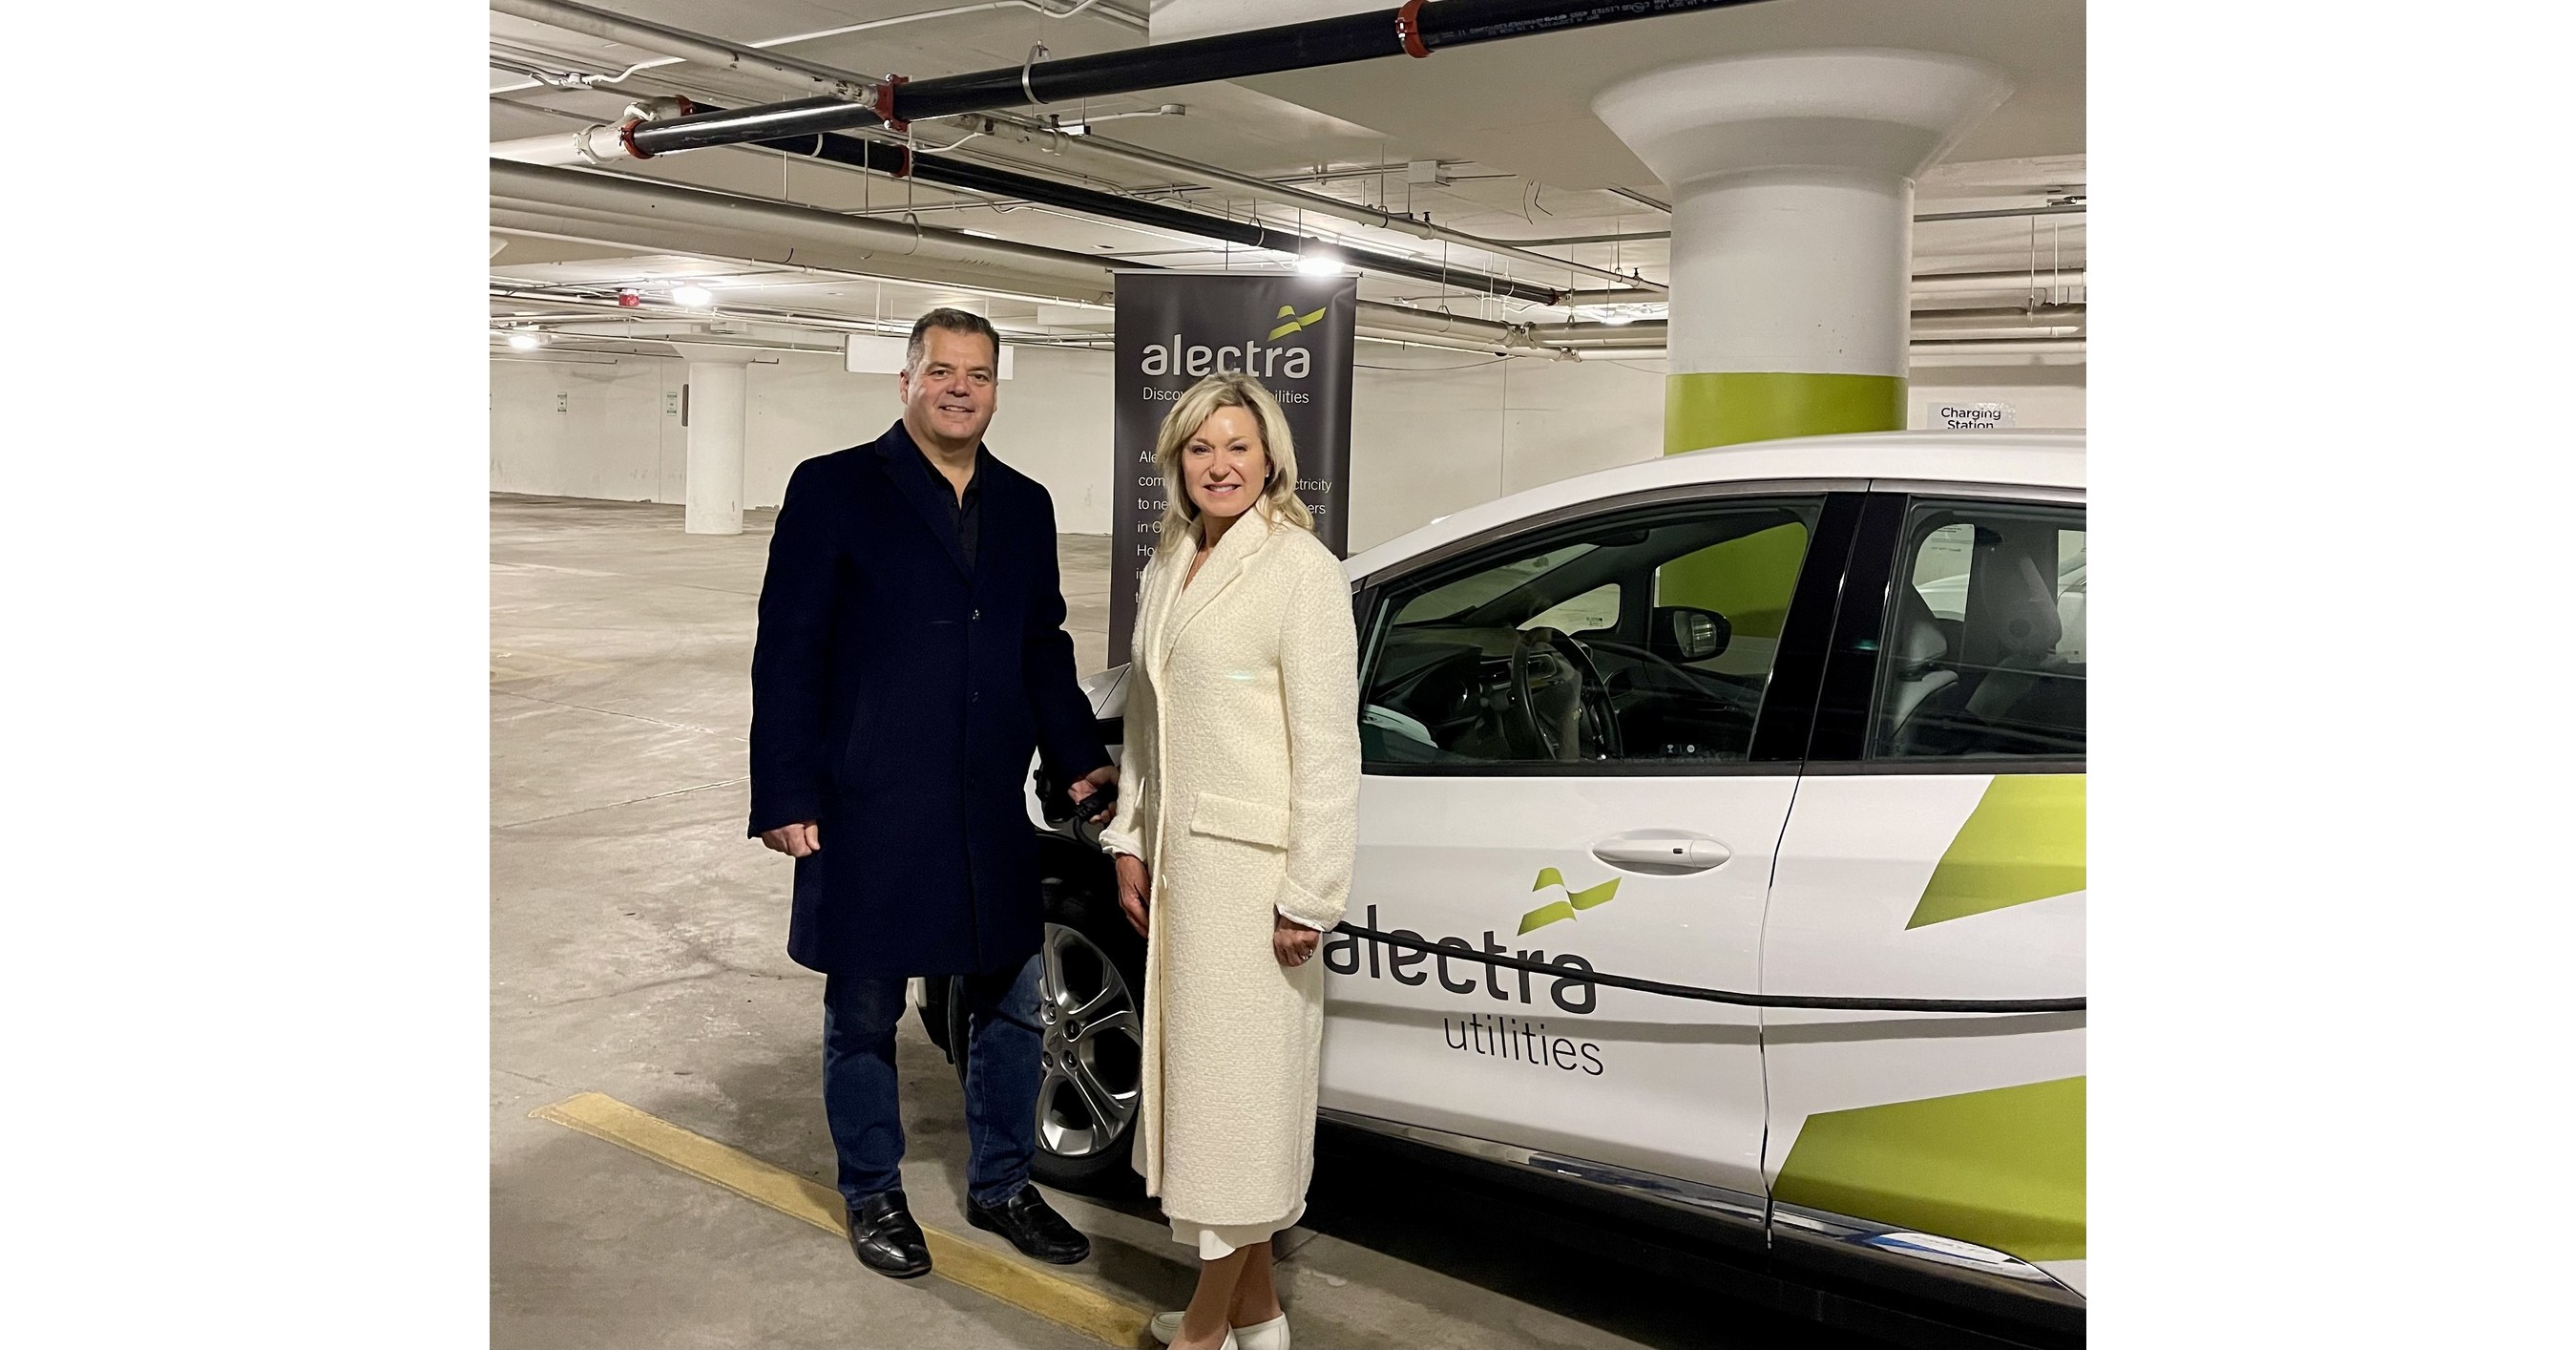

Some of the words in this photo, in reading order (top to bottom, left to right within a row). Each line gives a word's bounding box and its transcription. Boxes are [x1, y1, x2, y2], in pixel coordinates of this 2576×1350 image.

[1141, 333, 1311, 379] alectra
[1940, 407, 2001, 421] Charging
[1947, 419, 1994, 430] Station
[1138, 497, 1150, 510] to
[1137, 520, 1148, 533] in
[1323, 903, 1597, 1015] alectra
[1443, 1013, 1604, 1076] utilities
